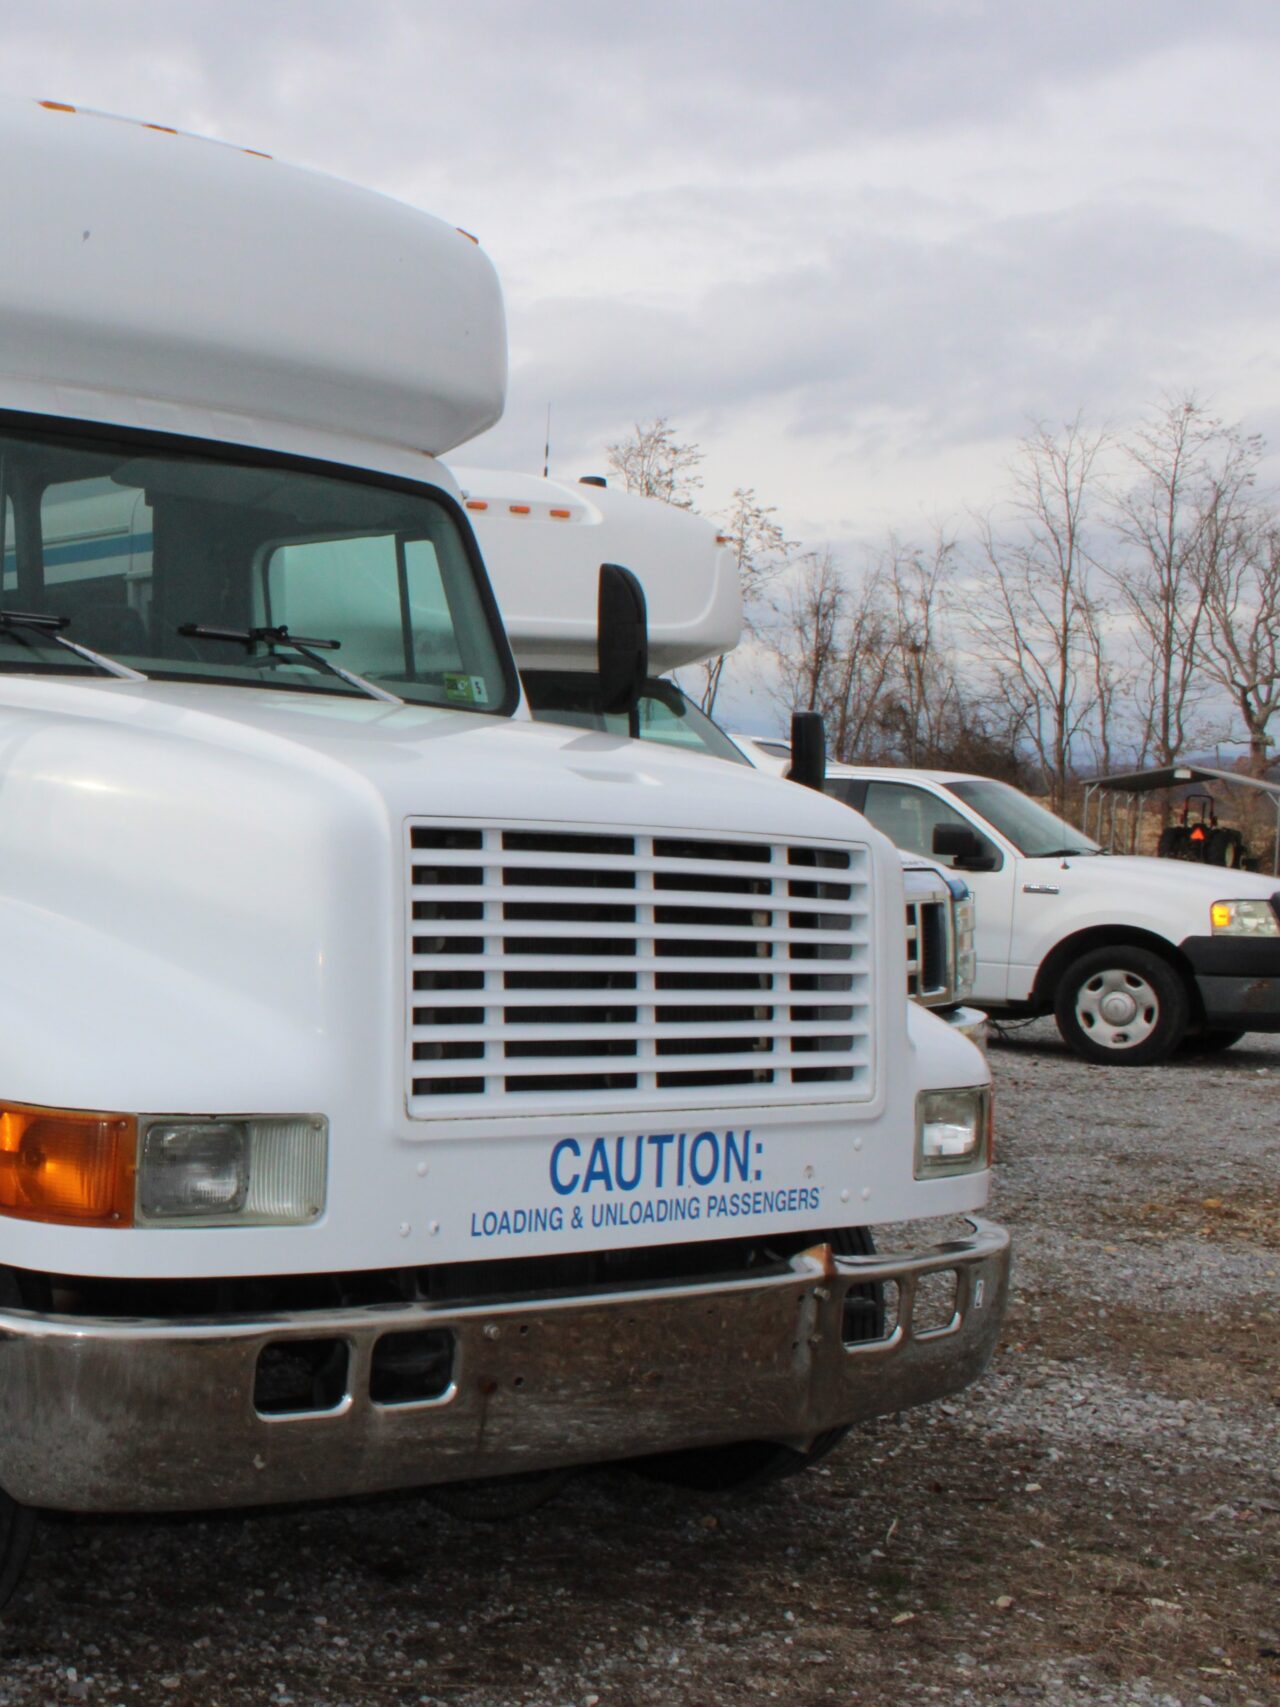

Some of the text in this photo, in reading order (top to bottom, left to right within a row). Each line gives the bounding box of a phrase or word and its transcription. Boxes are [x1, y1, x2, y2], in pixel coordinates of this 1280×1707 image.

[550, 1130, 764, 1196] CAUTION:
[471, 1187, 820, 1237] LOADING & UNLOADING PASSENGERS
